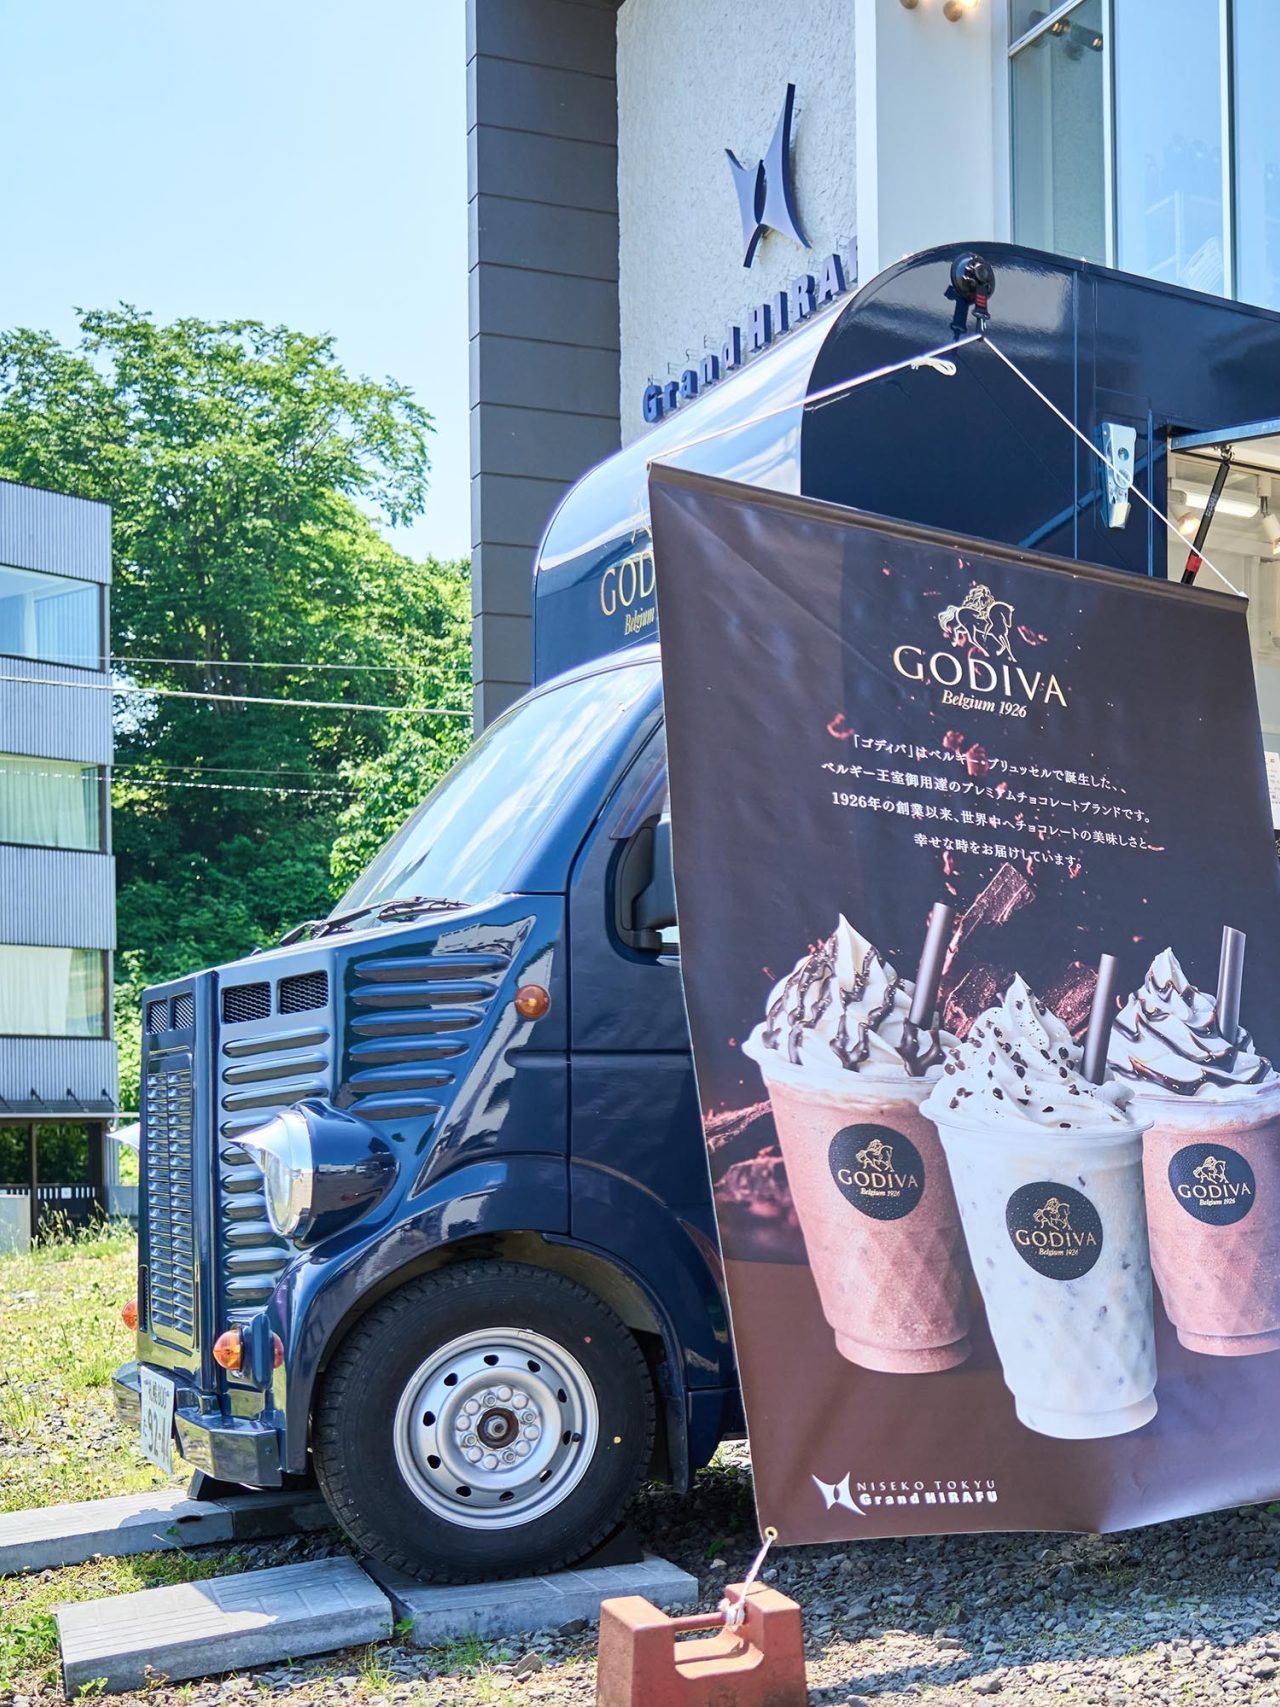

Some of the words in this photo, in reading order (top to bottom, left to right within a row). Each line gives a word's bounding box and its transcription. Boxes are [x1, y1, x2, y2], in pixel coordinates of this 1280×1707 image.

[643, 326, 741, 424] Grand
[893, 645, 1068, 707] GODIVA
[942, 689, 996, 712] Belgium
[999, 701, 1028, 718] 1926
[837, 1168, 919, 1189] GODIVA
[860, 1187, 886, 1198] Belgium
[1176, 1182, 1252, 1199] GODIVA
[1015, 1229, 1098, 1248] GODIVA
[1038, 1247, 1065, 1257] Belgium
[856, 1481, 925, 1491] NISEKO
[933, 1480, 996, 1490] TOKYU
[859, 1492, 920, 1506] Grand
[924, 1490, 998, 1504] HIRAFU
